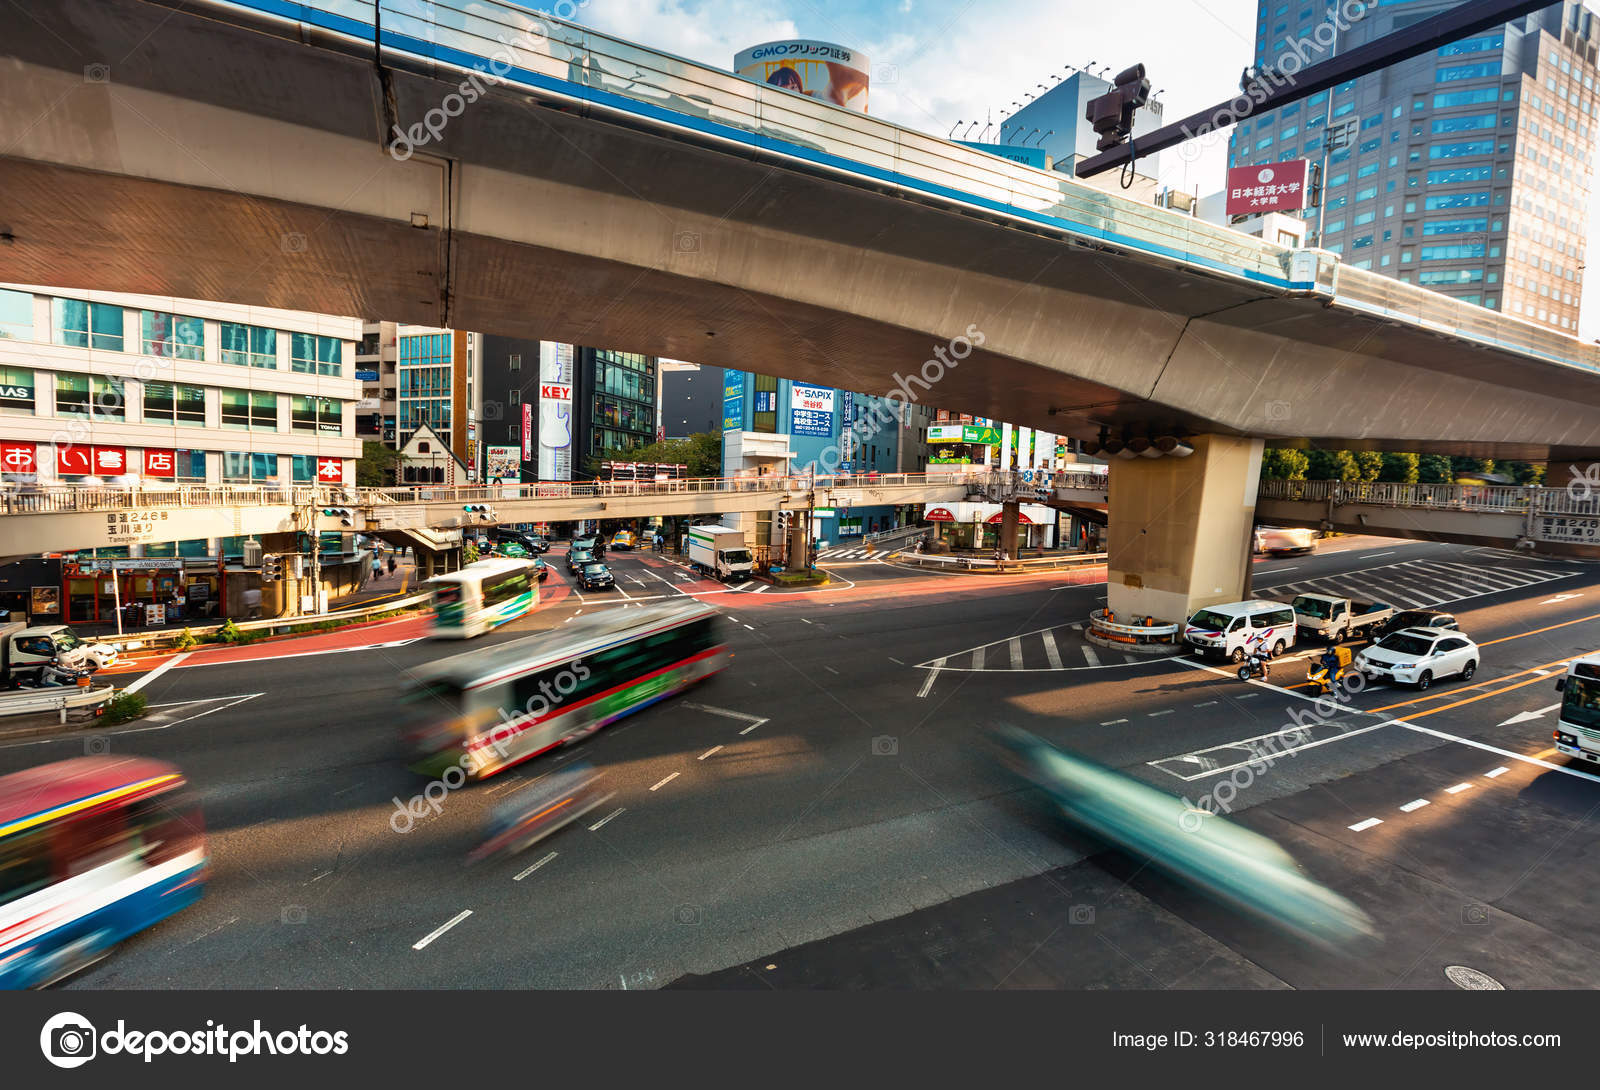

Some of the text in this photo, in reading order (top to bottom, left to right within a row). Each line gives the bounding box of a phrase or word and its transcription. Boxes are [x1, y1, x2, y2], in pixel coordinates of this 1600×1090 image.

[752, 44, 851, 61] GMOクリック証券
[1232, 182, 1300, 199] 日本経済大学
[1250, 196, 1278, 206] 大学院
[542, 385, 570, 398] KEY
[319, 460, 341, 478] 本
[107, 512, 168, 523] 国道246号
[108, 523, 153, 535] 玉川通り
[1542, 526, 1596, 537] 玉川通り
